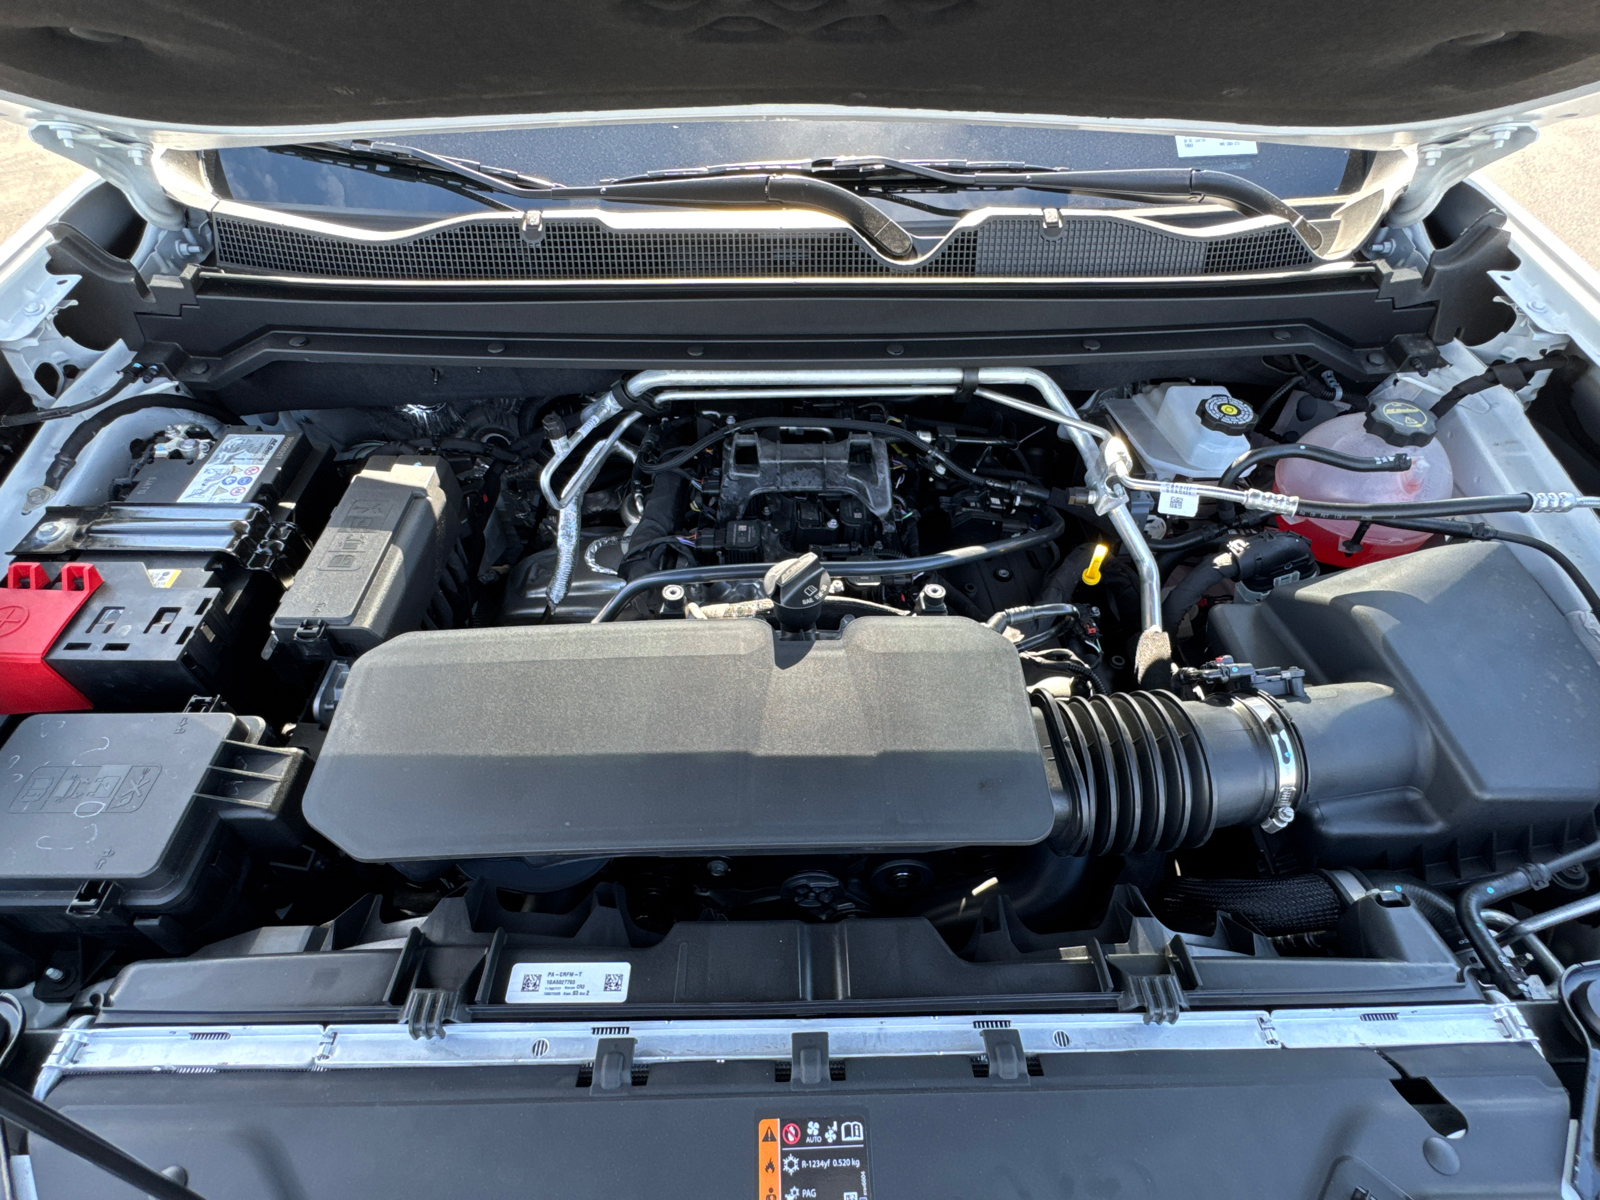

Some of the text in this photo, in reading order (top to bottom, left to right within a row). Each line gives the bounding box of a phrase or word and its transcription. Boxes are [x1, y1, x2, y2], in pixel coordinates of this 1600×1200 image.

[801, 597, 815, 605] SAE
[801, 1158, 860, 1169] R-1234yf 0.520 kg
[801, 1189, 817, 1198] PAG
